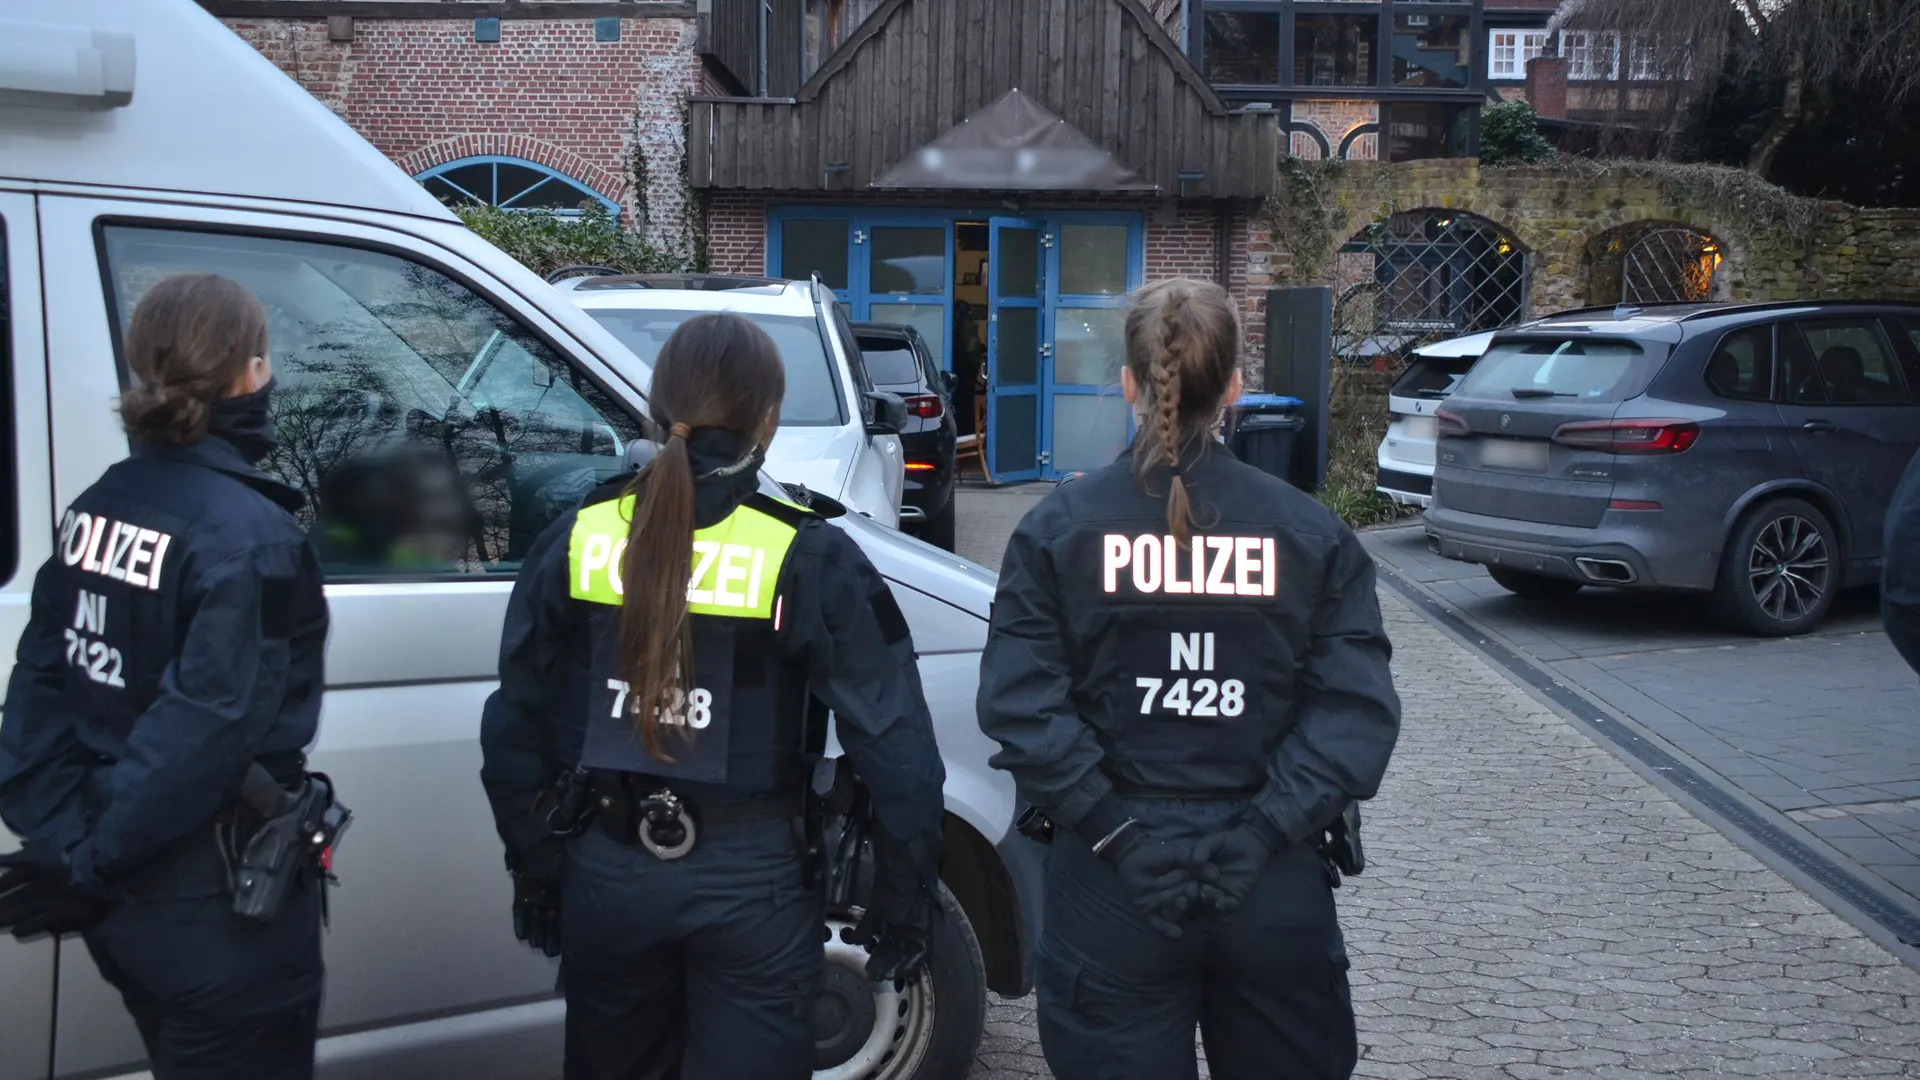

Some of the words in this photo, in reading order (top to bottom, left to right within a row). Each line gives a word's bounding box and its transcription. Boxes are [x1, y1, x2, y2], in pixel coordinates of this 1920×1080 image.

[59, 509, 171, 590] POLIZEI
[580, 533, 765, 608] POZEI
[1104, 534, 1275, 596] POLIZEI
[75, 589, 107, 635] NI
[1170, 632, 1215, 671] NI
[1136, 677, 1245, 717] 7428
